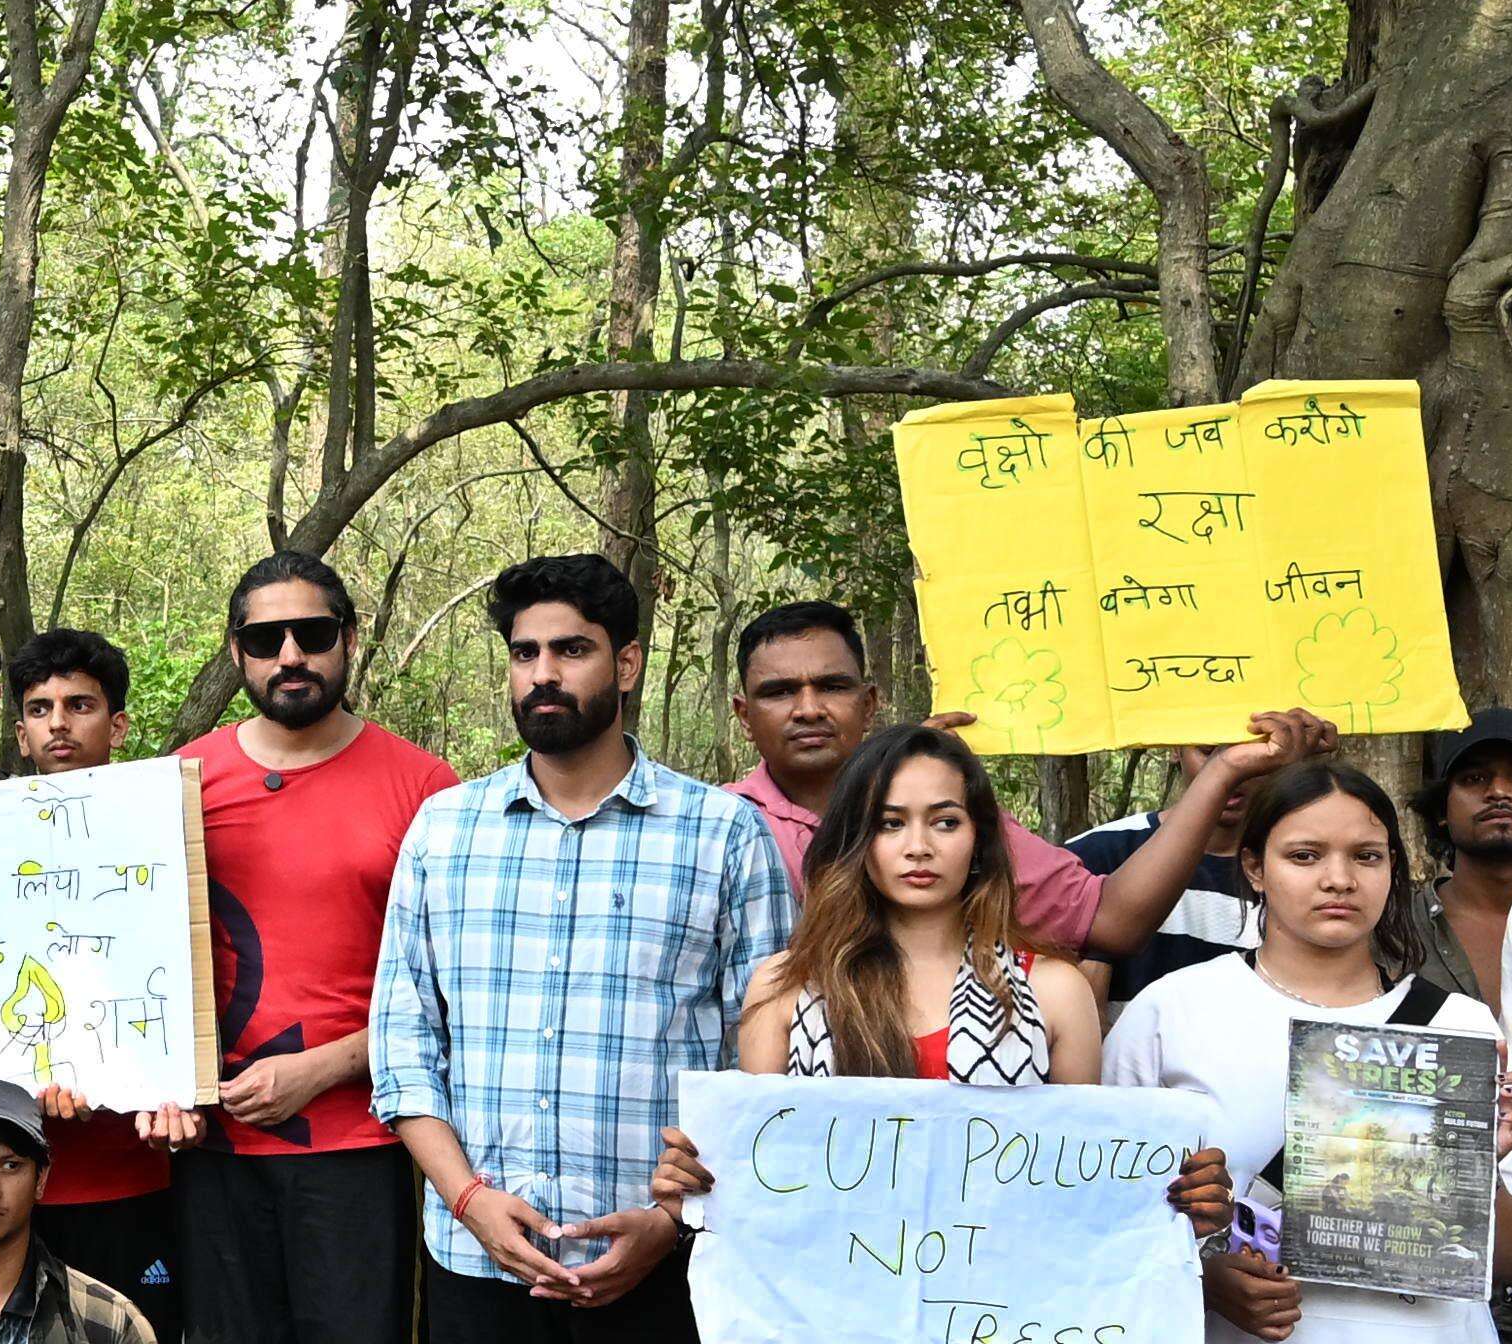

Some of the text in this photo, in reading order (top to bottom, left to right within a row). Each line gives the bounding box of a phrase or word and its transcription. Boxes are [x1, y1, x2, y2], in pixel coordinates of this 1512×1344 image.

[1082, 416, 1136, 468] की
[1165, 418, 1230, 456] जब
[1138, 491, 1255, 544] रक्षा
[1099, 575, 1198, 616] बनेगा
[1265, 562, 1364, 604] जीवन
[1111, 655, 1251, 691] अच्छा
[22, 780, 93, 840] को
[11, 860, 80, 901] लिया
[45, 922, 116, 961] लोग
[1334, 1034, 1439, 1070] SAVE
[1344, 1061, 1438, 1096] TREES
[752, 1108, 915, 1194] CUT
[849, 1219, 987, 1276] NOT
[1306, 1230, 1434, 1259] TOGETHER WE PROTECT
[1309, 1214, 1423, 1241] TOGETHER WE GROW
[140, 1275, 170, 1285] adidas
